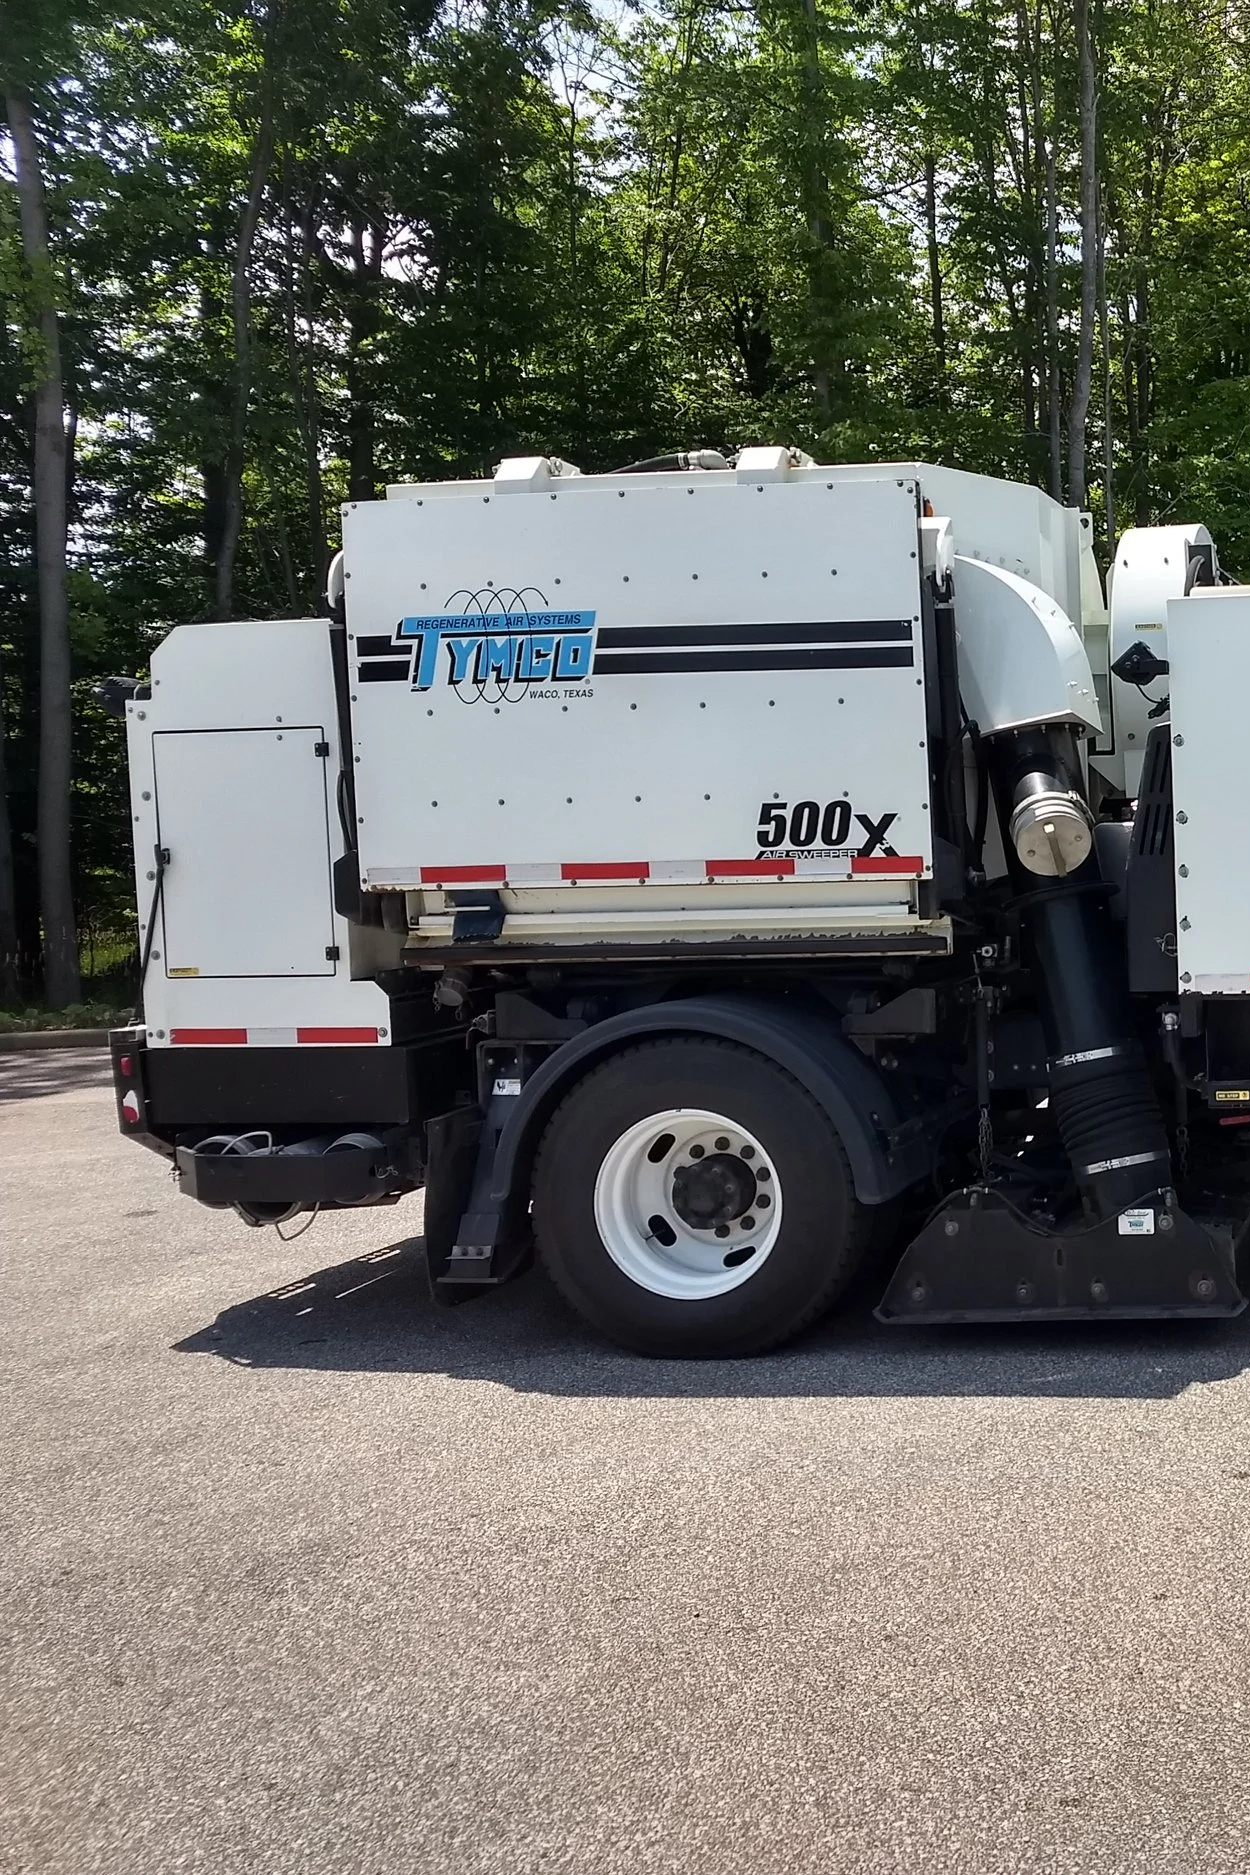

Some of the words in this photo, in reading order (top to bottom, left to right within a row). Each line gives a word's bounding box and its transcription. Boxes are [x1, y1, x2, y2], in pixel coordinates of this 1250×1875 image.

[416, 617, 499, 630] REGENERATIVE
[505, 617, 523, 627] AIR
[528, 614, 582, 627] SYSTEMS
[398, 612, 595, 691] TYMCO
[529, 690, 561, 700] WACO,
[563, 689, 594, 699] TEXAS
[762, 850, 786, 859] AIR
[789, 849, 858, 859] SWEEPER
